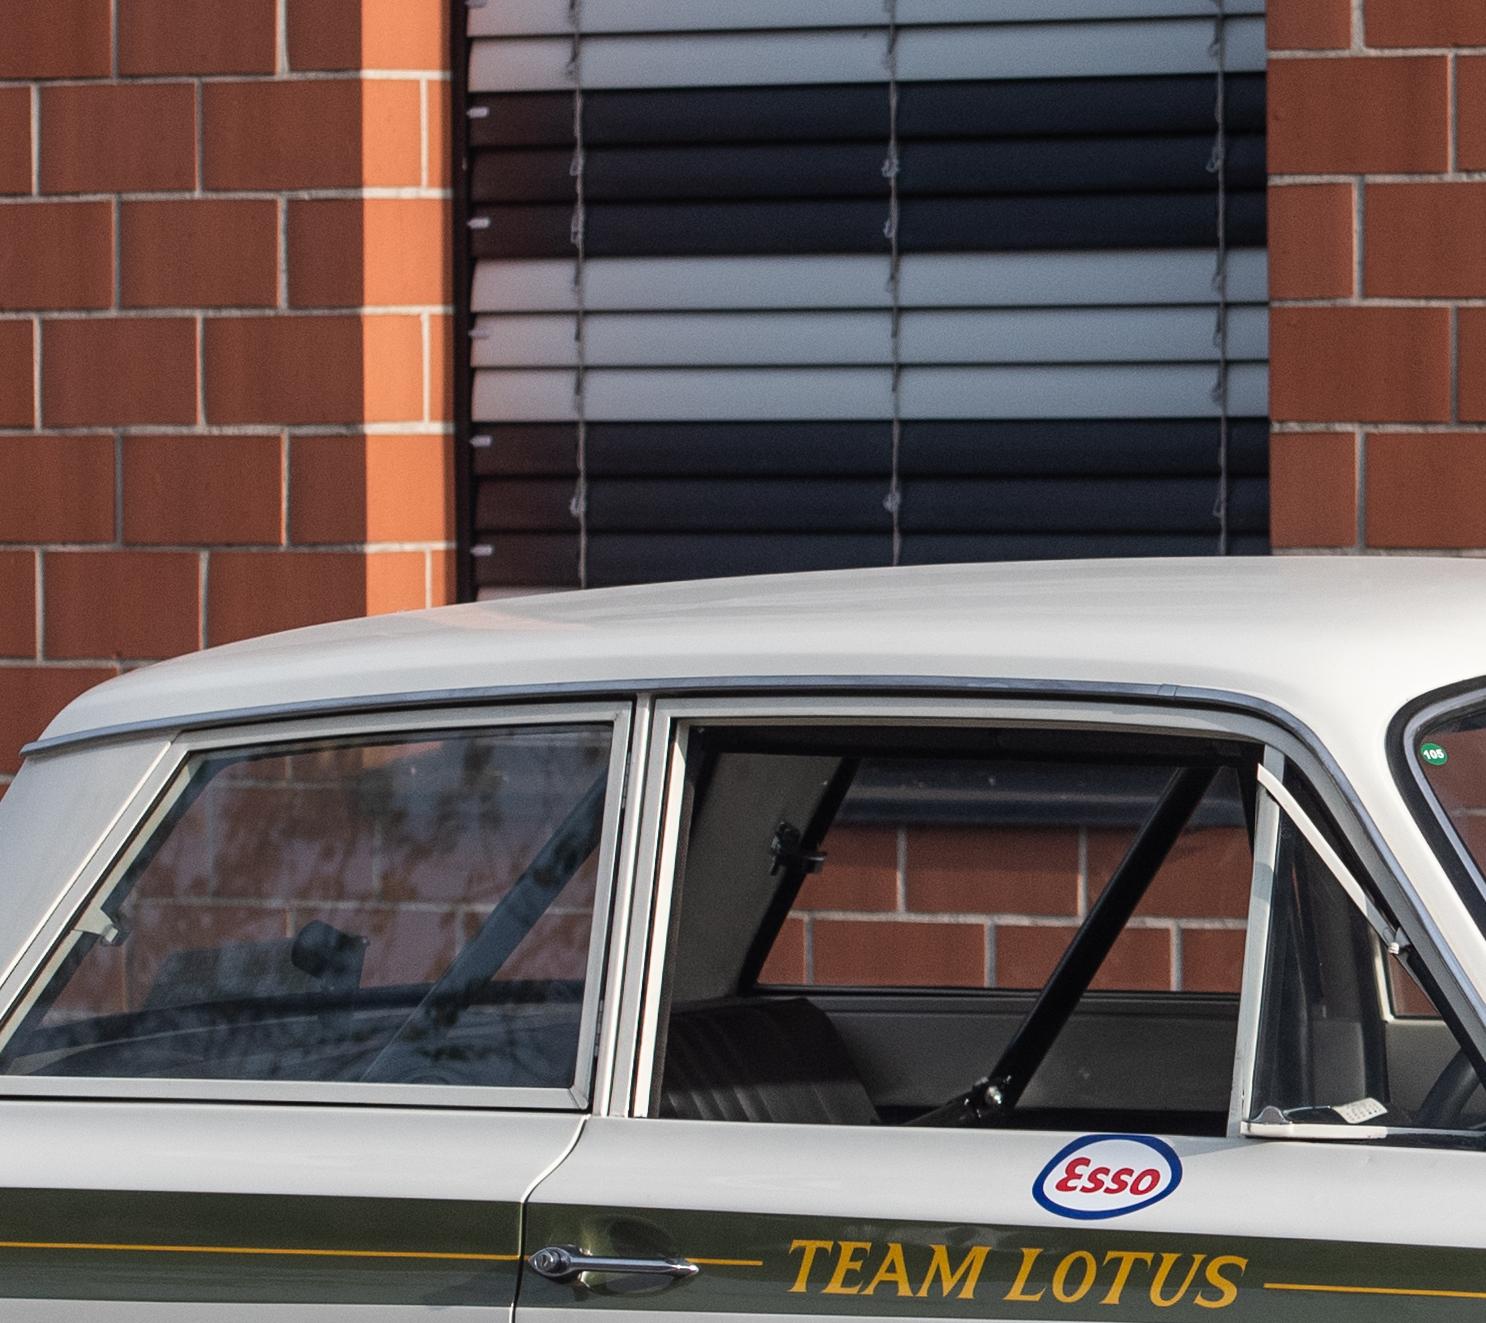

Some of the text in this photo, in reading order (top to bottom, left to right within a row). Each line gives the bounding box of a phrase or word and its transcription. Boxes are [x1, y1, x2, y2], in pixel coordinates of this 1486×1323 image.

[1423, 749, 1445, 760] 105
[787, 1238, 1250, 1309] TEAM LOTUS
